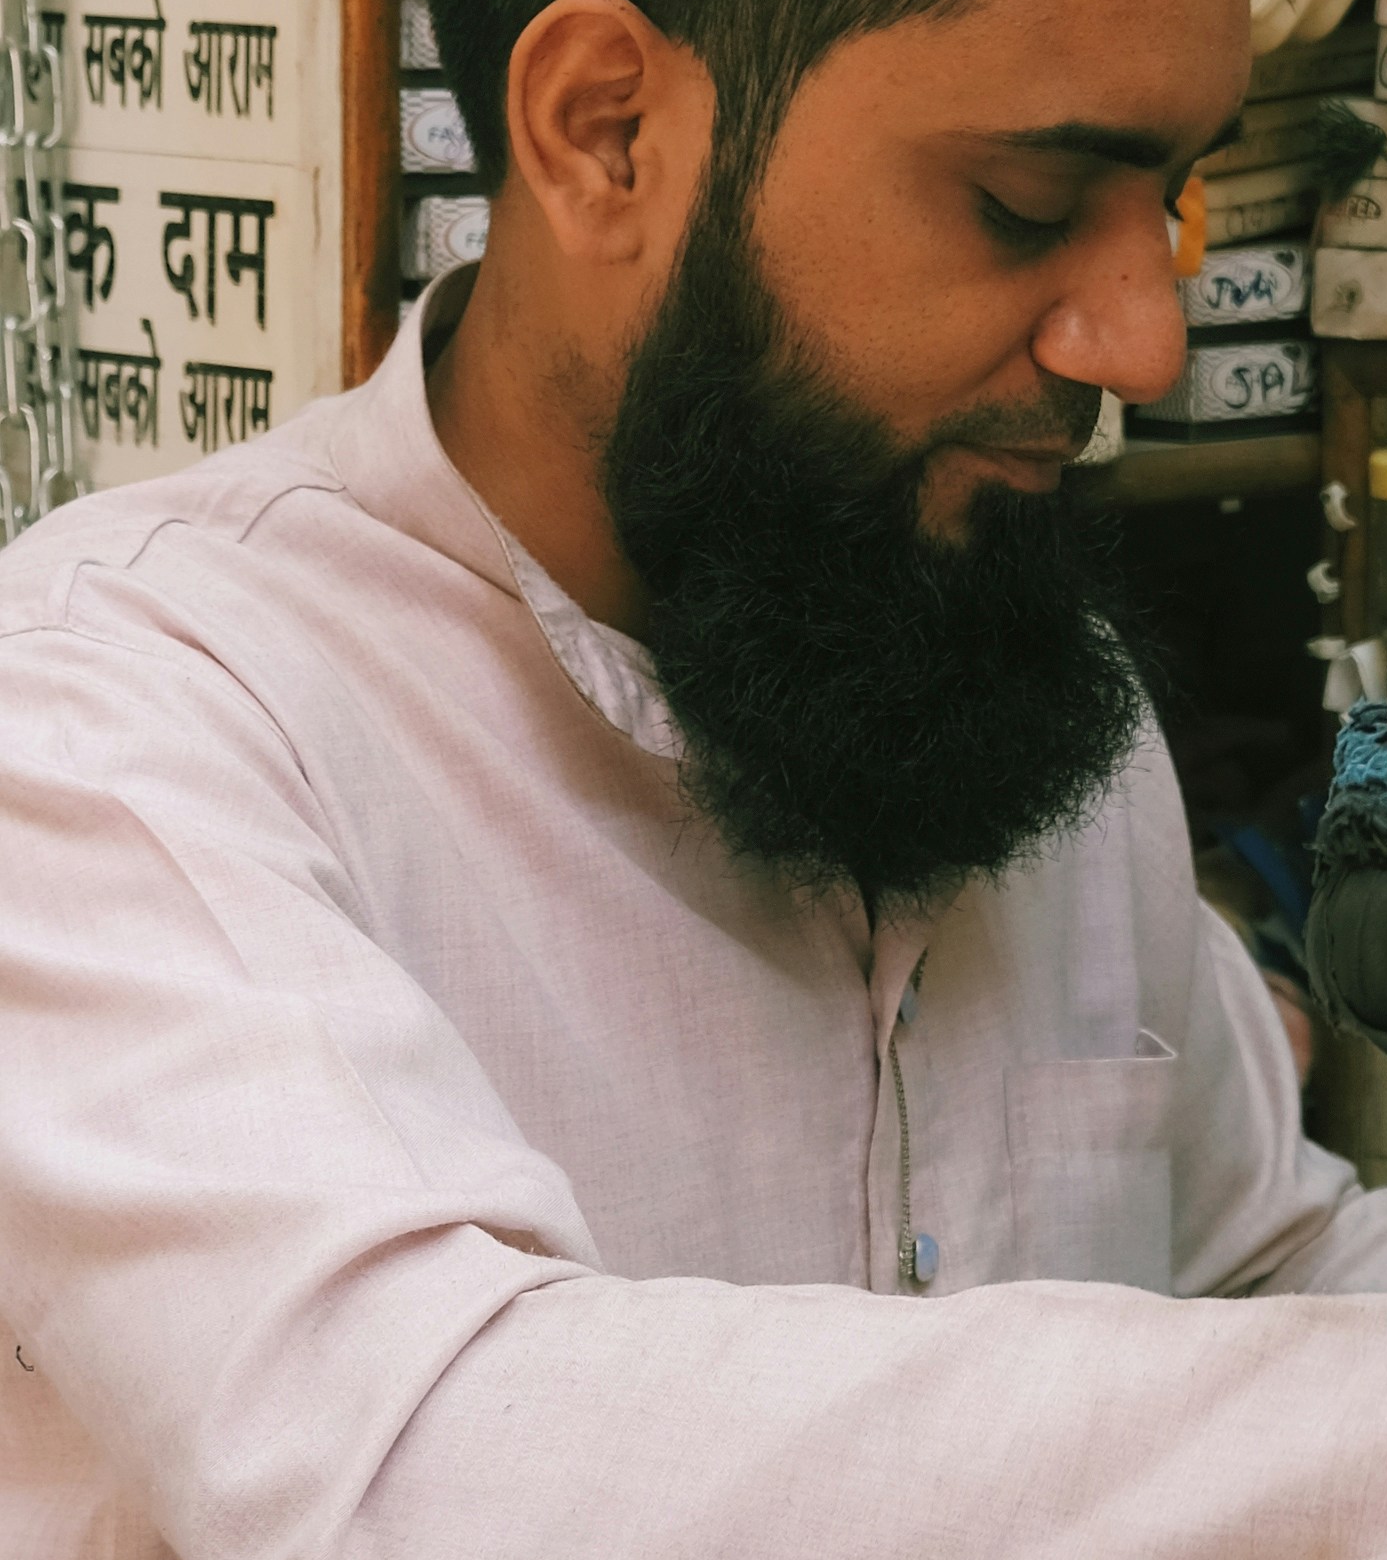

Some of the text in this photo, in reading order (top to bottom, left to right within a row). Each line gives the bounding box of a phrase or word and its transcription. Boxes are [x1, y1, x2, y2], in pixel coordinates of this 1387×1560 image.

[183, 21, 277, 122] आराम
[160, 192, 275, 330] दाम
[75, 318, 161, 451] सबको
